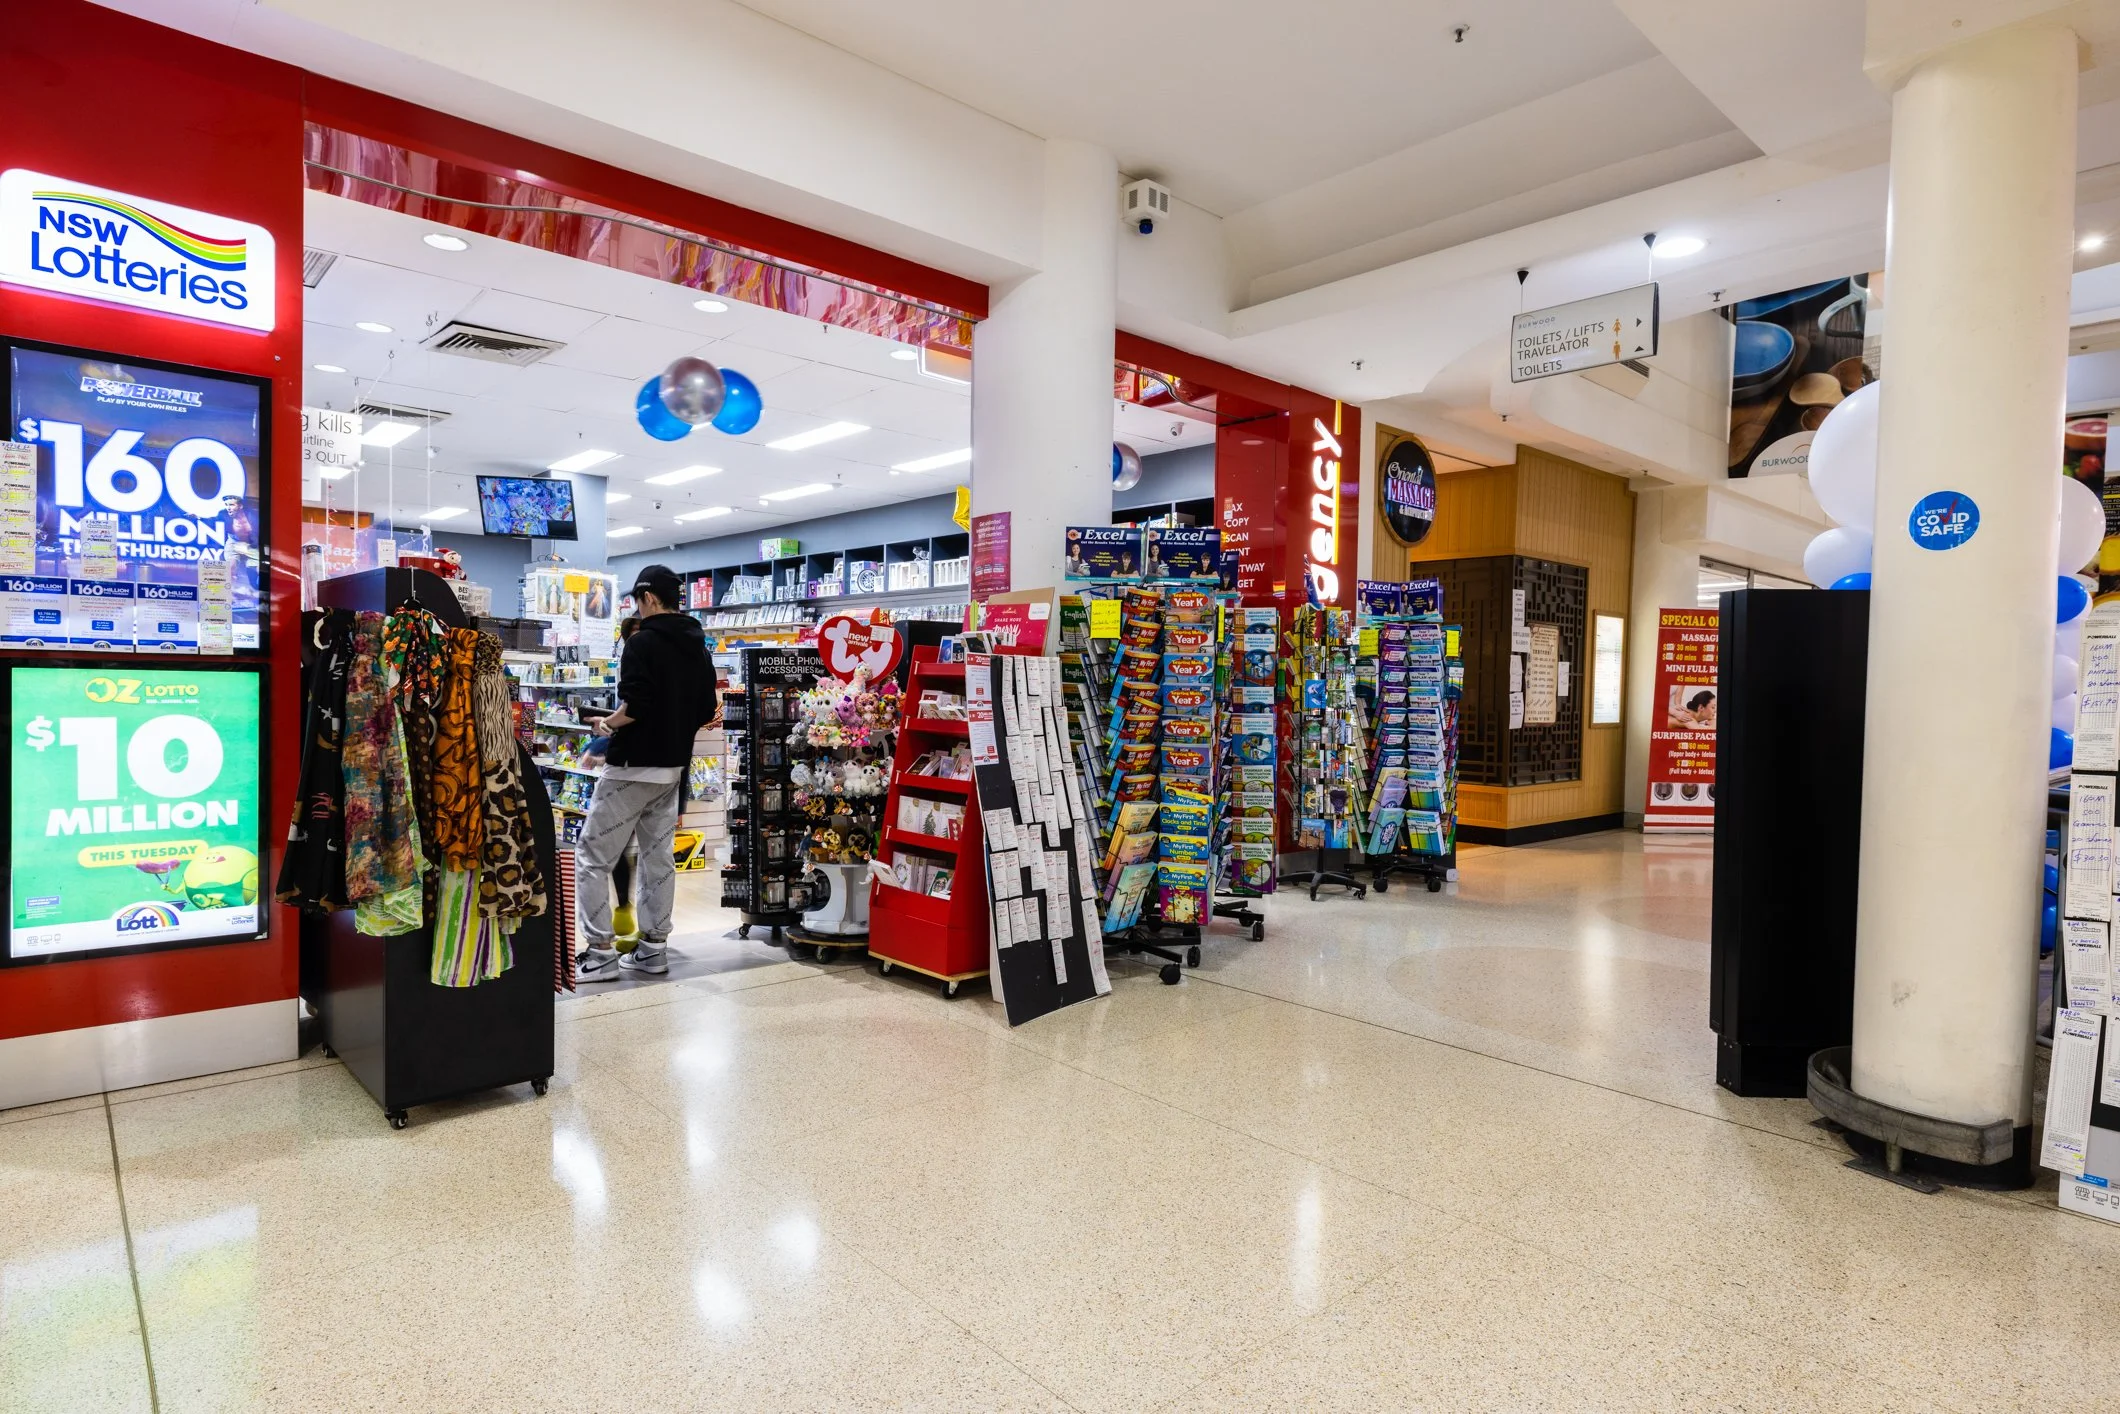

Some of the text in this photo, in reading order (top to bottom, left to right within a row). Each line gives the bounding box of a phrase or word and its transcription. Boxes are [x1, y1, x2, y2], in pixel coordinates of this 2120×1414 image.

[39, 206, 129, 246] NSW
[31, 231, 248, 310] Lotteries
[1518, 321, 1604, 349] TOILETS / LIFTS
[1517, 337, 1589, 361] TRAVELATOR
[1518, 359, 1562, 377] TOILETS
[80, 376, 203, 407] POWERBALL
[97, 396, 114, 404] PLAY
[127, 400, 147, 408] YOUR
[166, 405, 187, 413] RULES
[319, 412, 352, 434] kills
[316, 450, 347, 465] QUIT
[1387, 478, 1435, 509] MASSAGE
[1226, 517, 1249, 528] COPY
[1084, 529, 1124, 541] Excel
[1921, 523, 1964, 537] SAFE
[1164, 530, 1204, 542] Excel
[1225, 532, 1249, 543] SCAN
[117, 541, 224, 561] THURSDAY
[1368, 582, 1391, 591] Excel
[1409, 581, 1429, 590] Excel
[1174, 597, 1204, 607] Year K
[1064, 608, 1086, 619] English
[1661, 615, 1706, 626] SPECIAL
[993, 624, 1021, 635] merry
[849, 632, 869, 642] new
[1175, 635, 1196, 644] Year
[847, 640, 869, 648] arrivals
[759, 657, 798, 666] MOBILE
[759, 666, 815, 674] ACCESSORIES
[1173, 665, 1202, 674] Year 2
[1665, 664, 1708, 673] MINI FULL
[1698, 676, 1709, 684] only
[85, 677, 199, 705] OZ LOTTO
[1172, 696, 1201, 704] Year 3
[1171, 726, 1200, 735] Year 4
[1652, 732, 1693, 740] SURPRISE
[26, 714, 224, 801] $10
[1170, 757, 1200, 765] Year 5
[45, 799, 239, 837] MILLION
[90, 845, 198, 862] THIS TUESDAY
[117, 915, 158, 932] Lott
